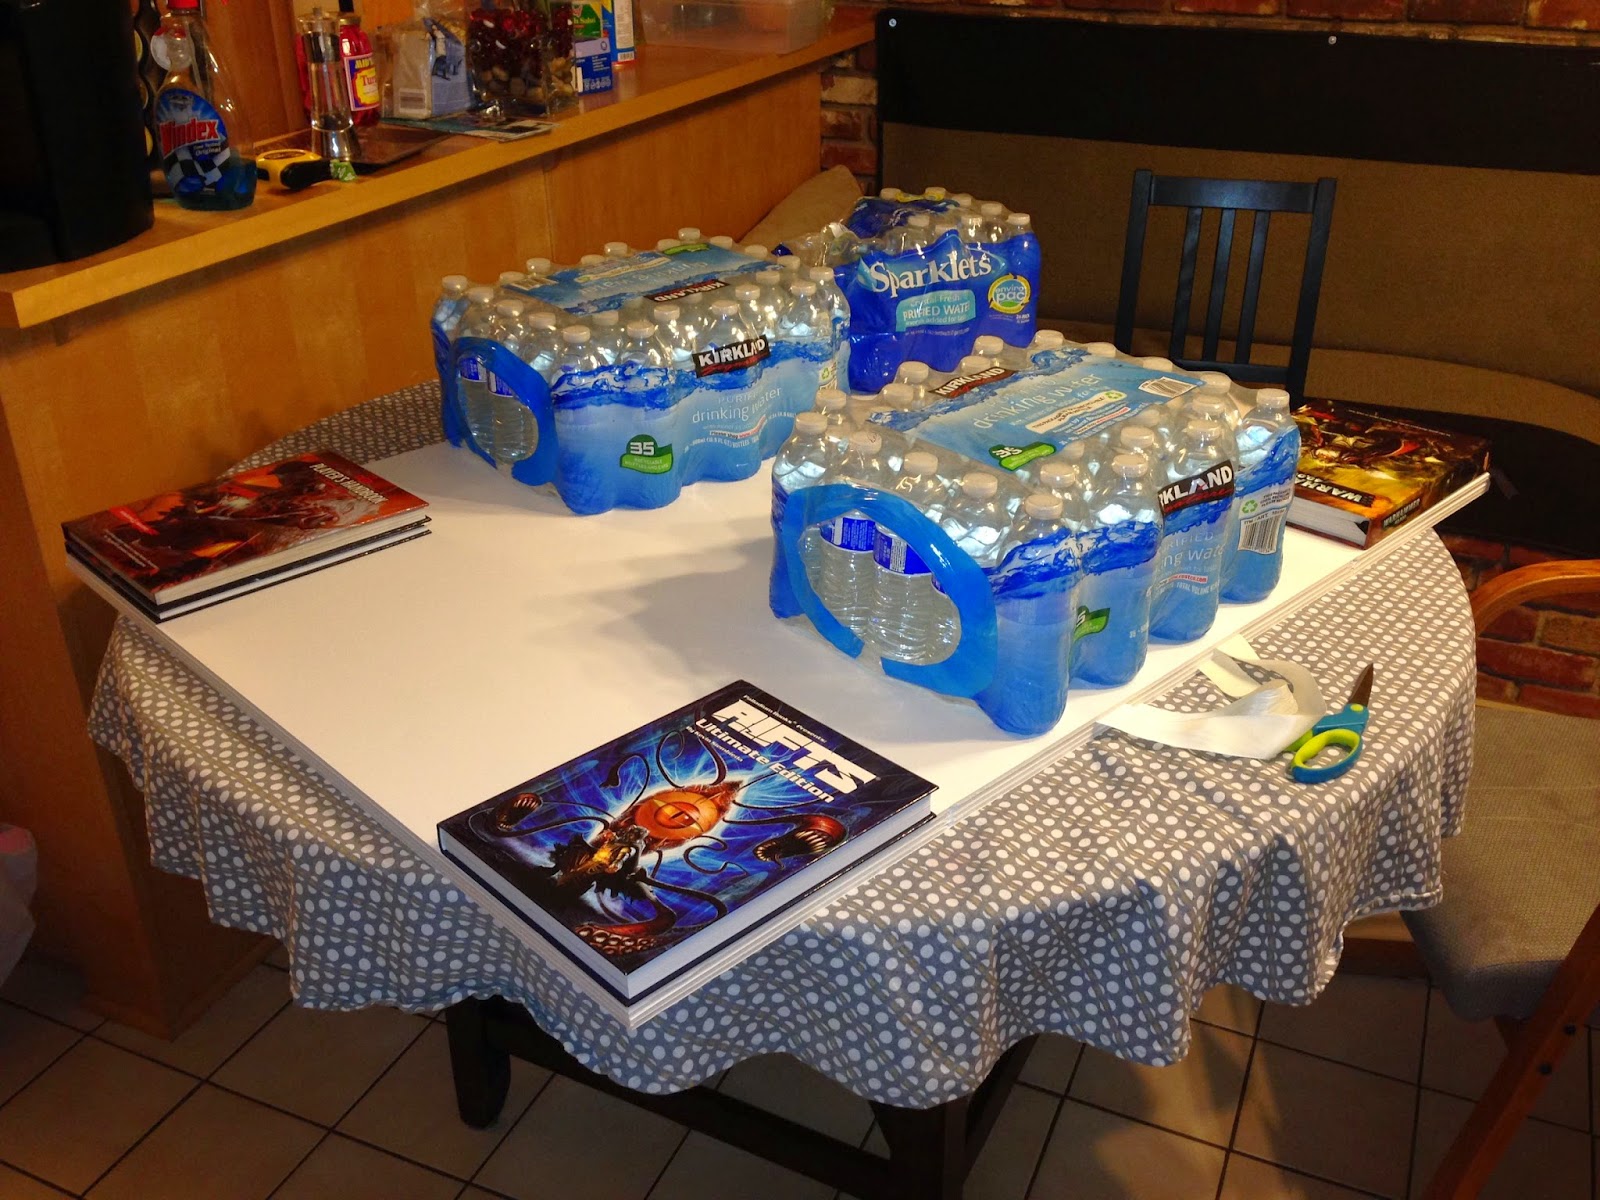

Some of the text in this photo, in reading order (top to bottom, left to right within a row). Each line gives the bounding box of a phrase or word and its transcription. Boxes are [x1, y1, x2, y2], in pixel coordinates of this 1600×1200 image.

[160, 117, 221, 160] Windex
[869, 252, 992, 299] Sparklets
[654, 281, 725, 302] KIRKLAND
[995, 284, 1025, 294] enviro
[996, 291, 1025, 304] pac
[934, 367, 1005, 396] KIRKLAND
[973, 394, 1057, 429] drinking
[1048, 373, 1103, 397] wter
[692, 405, 750, 424] drinking
[629, 441, 655, 456] 35
[992, 446, 1023, 458] 35
[1158, 465, 1233, 507] KLAND
[1294, 478, 1363, 503] WARHA
[685, 725, 695, 734] By
[694, 731, 712, 743] Kevin
[711, 699, 877, 794] RIFTS
[695, 718, 835, 803] Ultimate Edition
